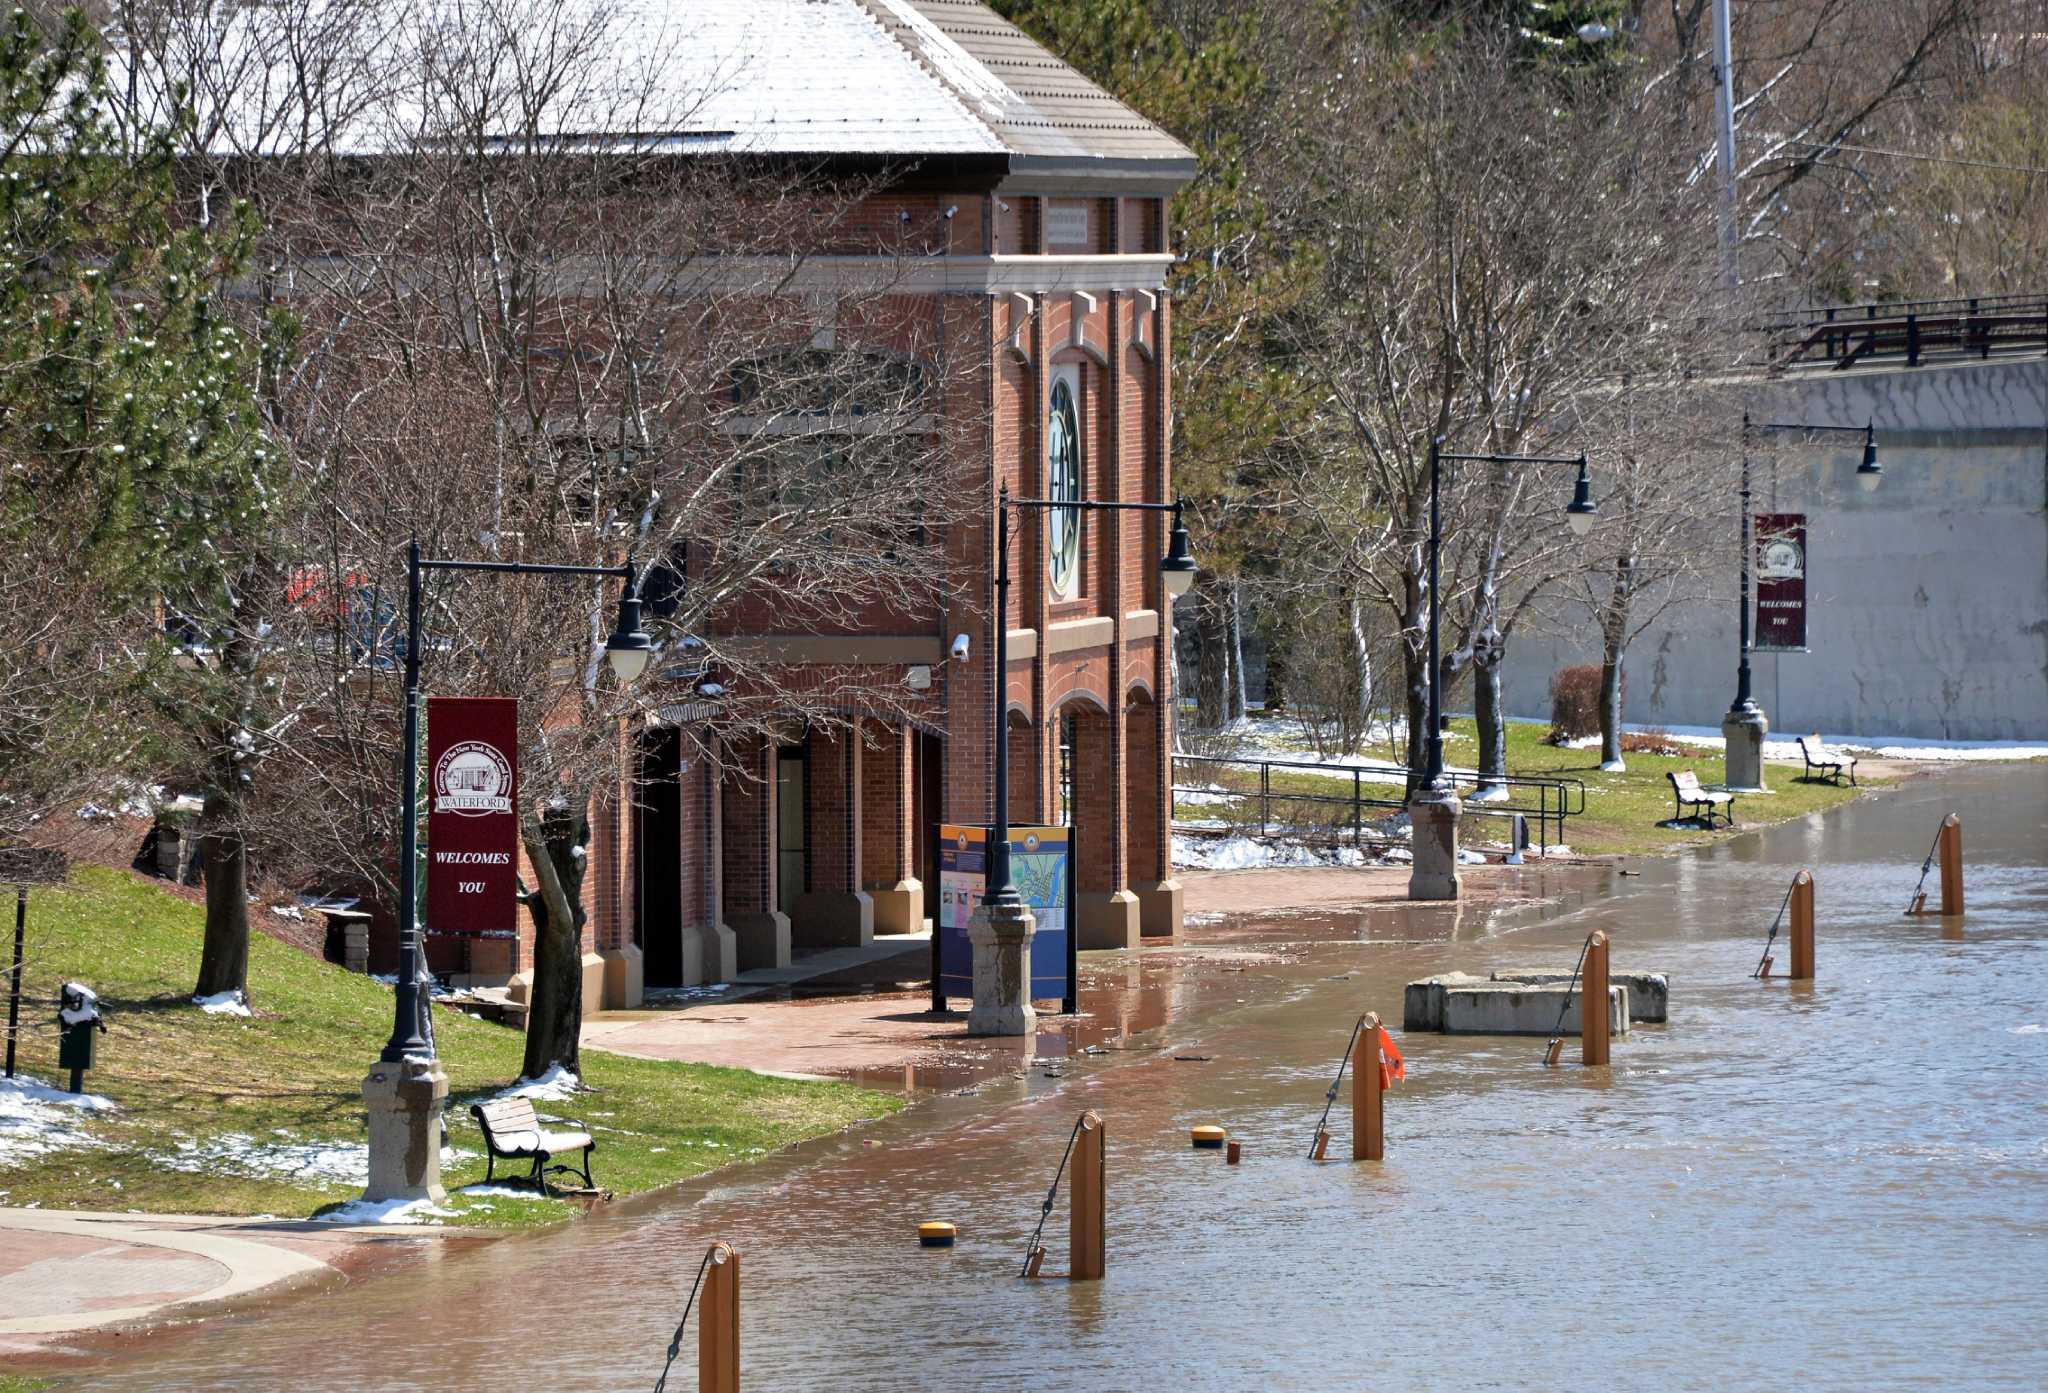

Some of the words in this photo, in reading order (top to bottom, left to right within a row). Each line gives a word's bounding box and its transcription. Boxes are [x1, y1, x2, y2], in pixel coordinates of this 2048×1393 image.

[441, 797, 505, 808] WATERFORD
[436, 852, 510, 864] WELCOMES
[458, 882, 485, 893] YOU
